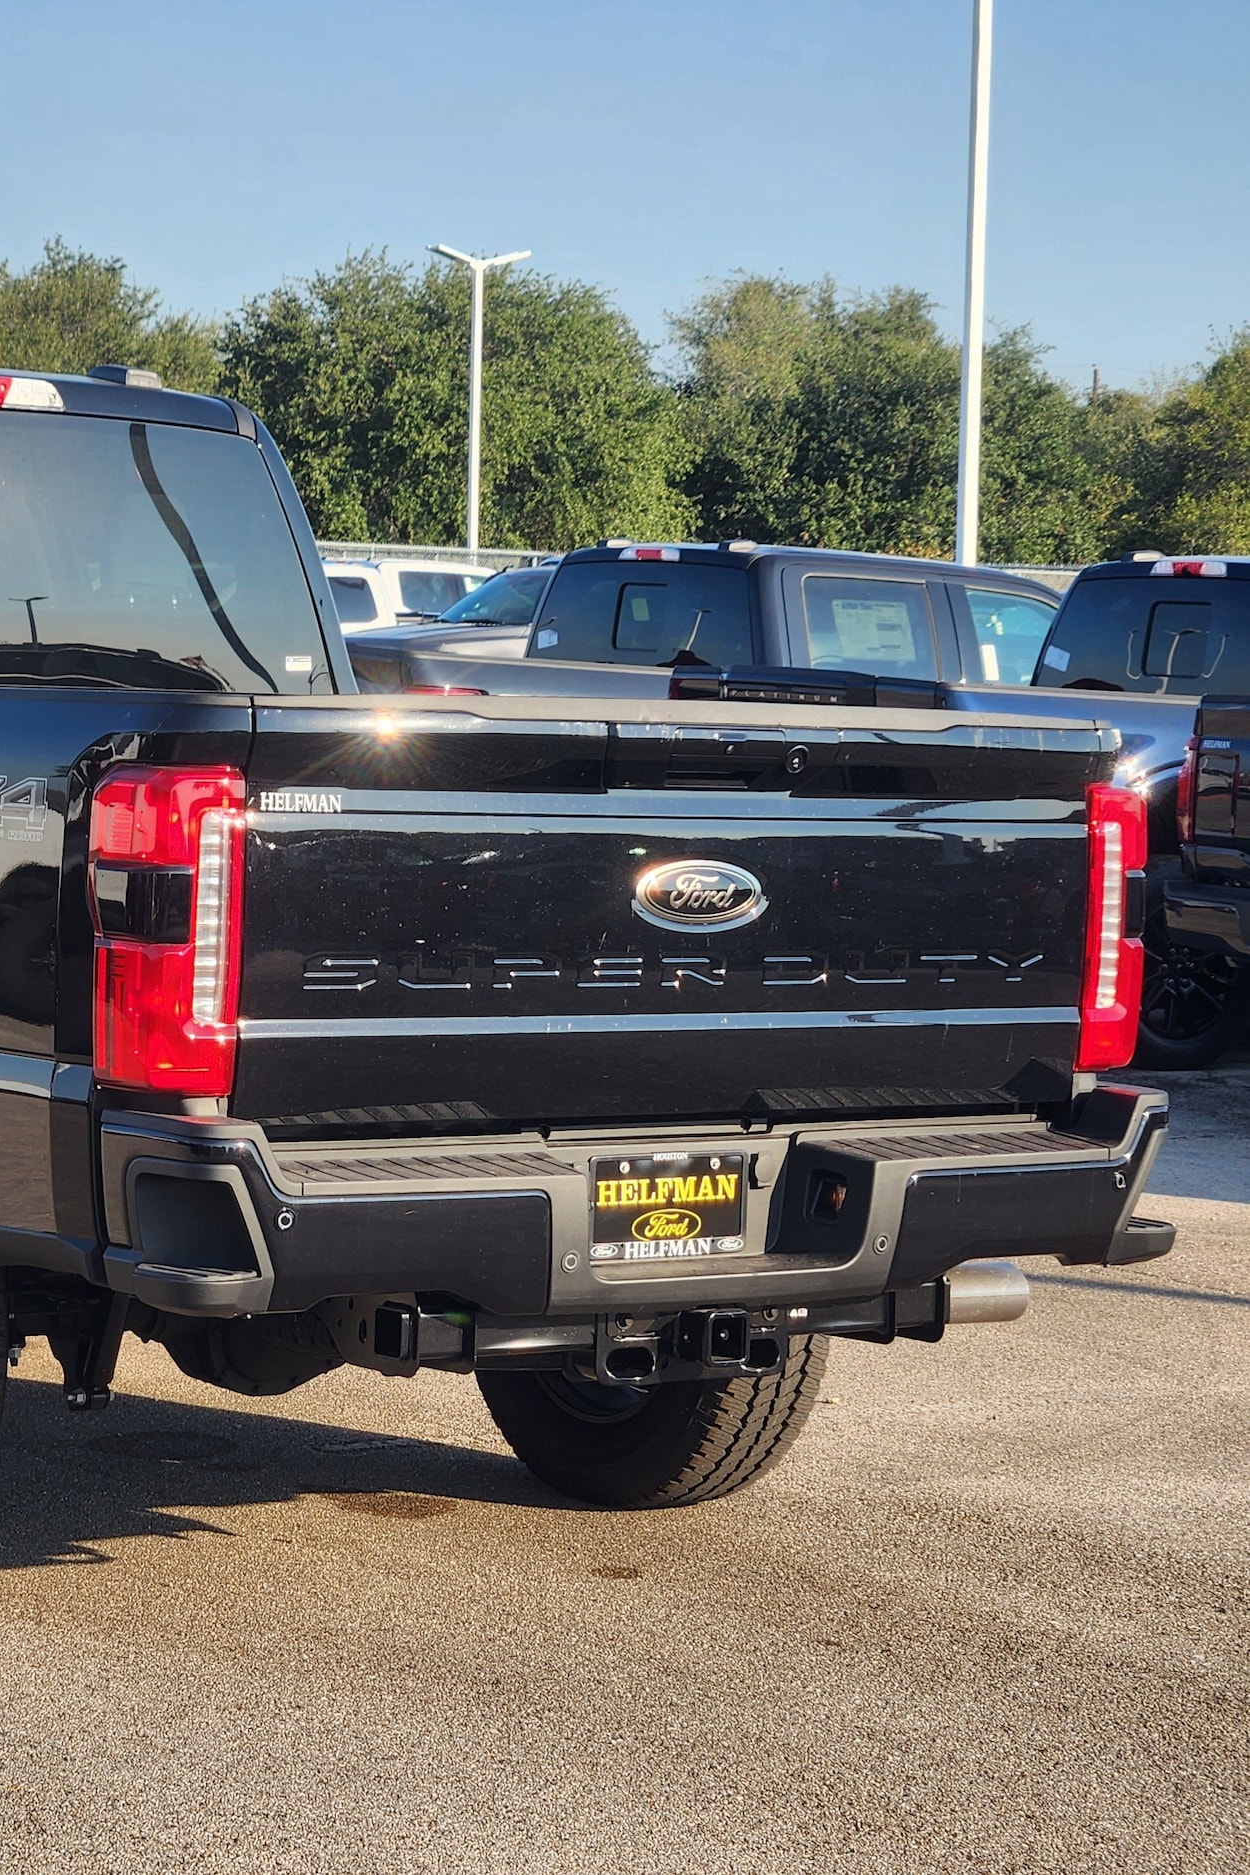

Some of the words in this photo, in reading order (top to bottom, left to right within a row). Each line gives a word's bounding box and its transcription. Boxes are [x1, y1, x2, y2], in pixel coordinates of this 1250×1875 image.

[730, 689, 839, 703] PLATINUM
[259, 791, 342, 813] HELFMAN
[7, 829, 44, 842] ROAD
[669, 873, 737, 910] Ford
[302, 951, 727, 990] SUPER
[761, 949, 1045, 986] DUTY
[652, 1152, 689, 1162] HOUSTON
[596, 1174, 739, 1207] HELFMAN
[644, 1213, 690, 1237] Ford
[594, 1245, 613, 1256] Ford
[623, 1236, 713, 1260] HELFMAN
[721, 1238, 740, 1249] Ford
